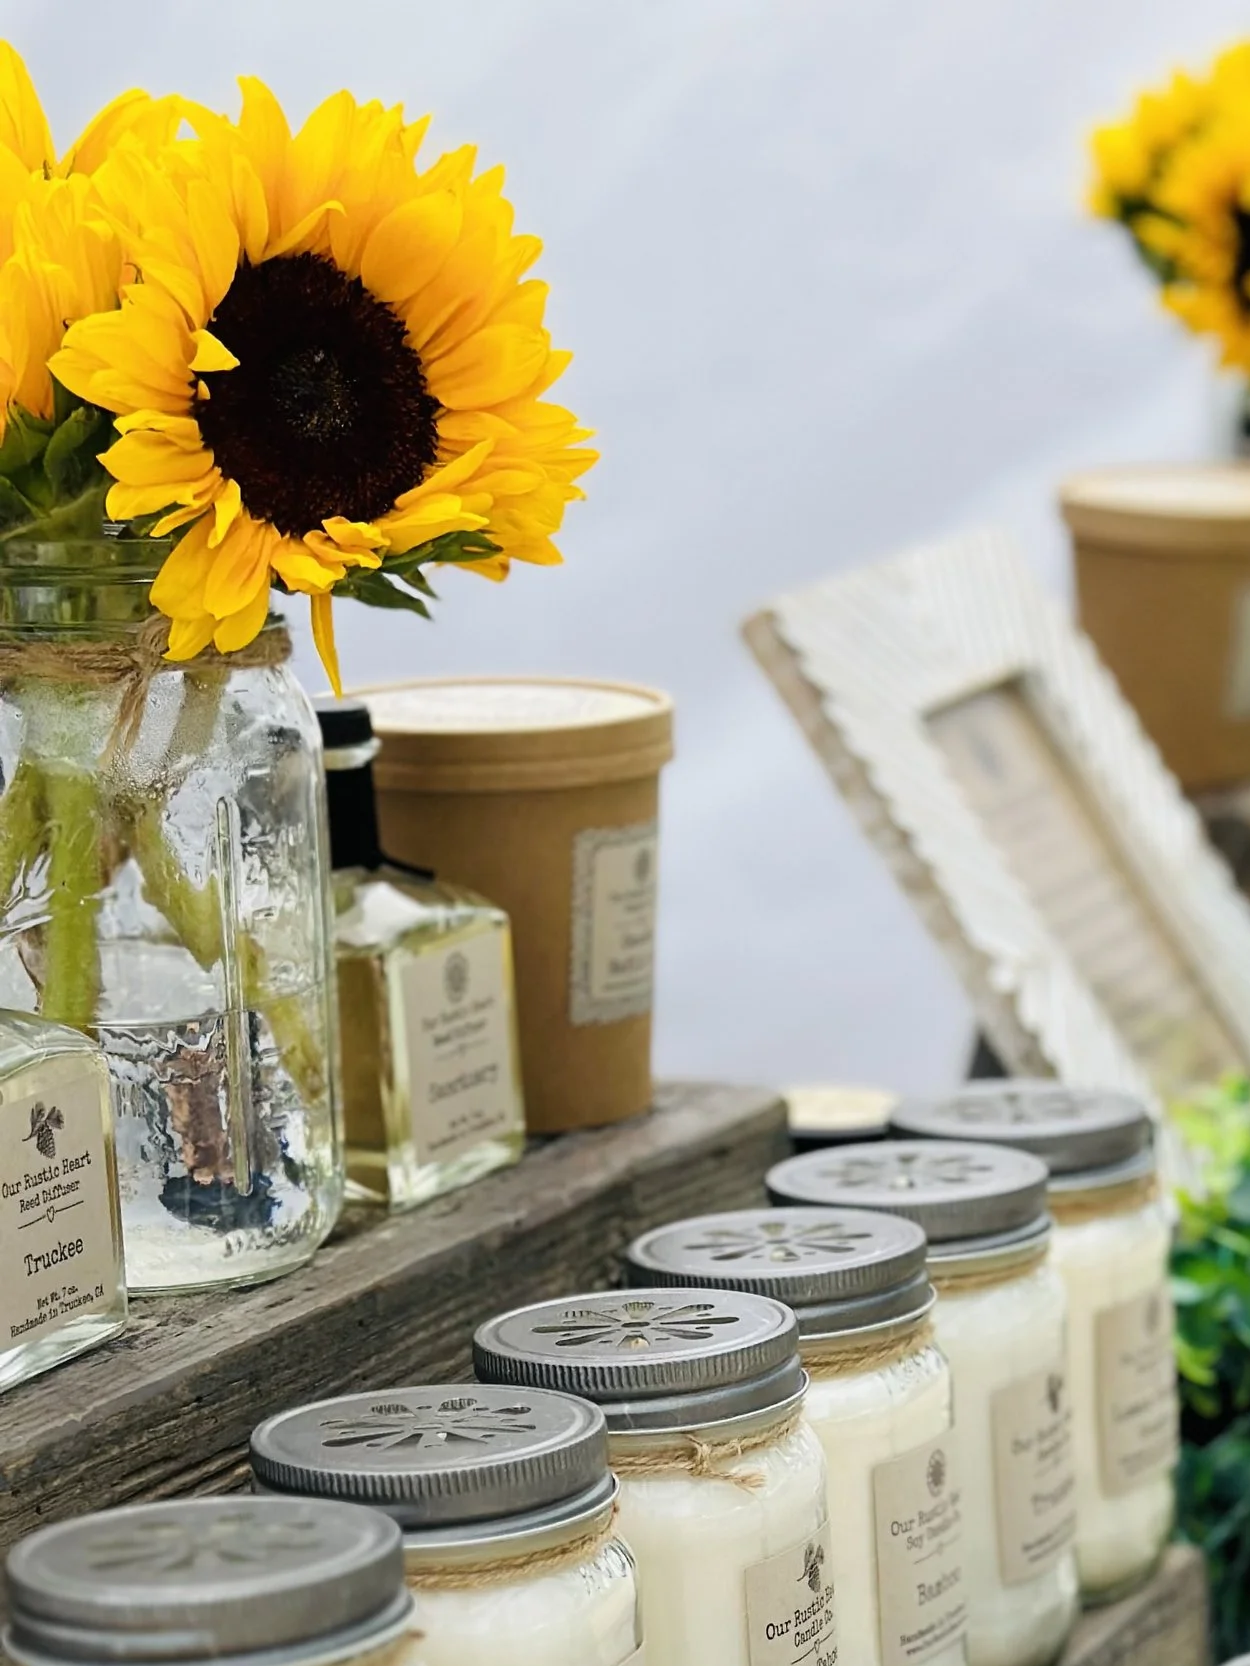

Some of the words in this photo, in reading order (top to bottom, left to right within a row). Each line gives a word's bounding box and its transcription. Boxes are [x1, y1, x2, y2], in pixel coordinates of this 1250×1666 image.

[2, 1183, 21, 1198] Our
[24, 1166, 60, 1190] Rustic
[62, 1150, 91, 1175] Heart
[20, 1193, 40, 1213] Reed
[42, 1180, 80, 1203] Diffuser
[24, 1238, 84, 1276] Truckee
[10, 1313, 47, 1337] Handmade
[48, 1309, 58, 1320] in
[60, 1293, 93, 1314] Truckee,
[95, 1283, 104, 1298] CA
[37, 1297, 49, 1310] Net
[50, 1292, 60, 1303] Wt.
[62, 1286, 66, 1298] 7
[68, 1285, 78, 1295] oz.
[891, 1518, 915, 1536] Our
[766, 1620, 791, 1640] Our
[794, 1596, 825, 1627] Rustic
[794, 1619, 823, 1648] Candle
